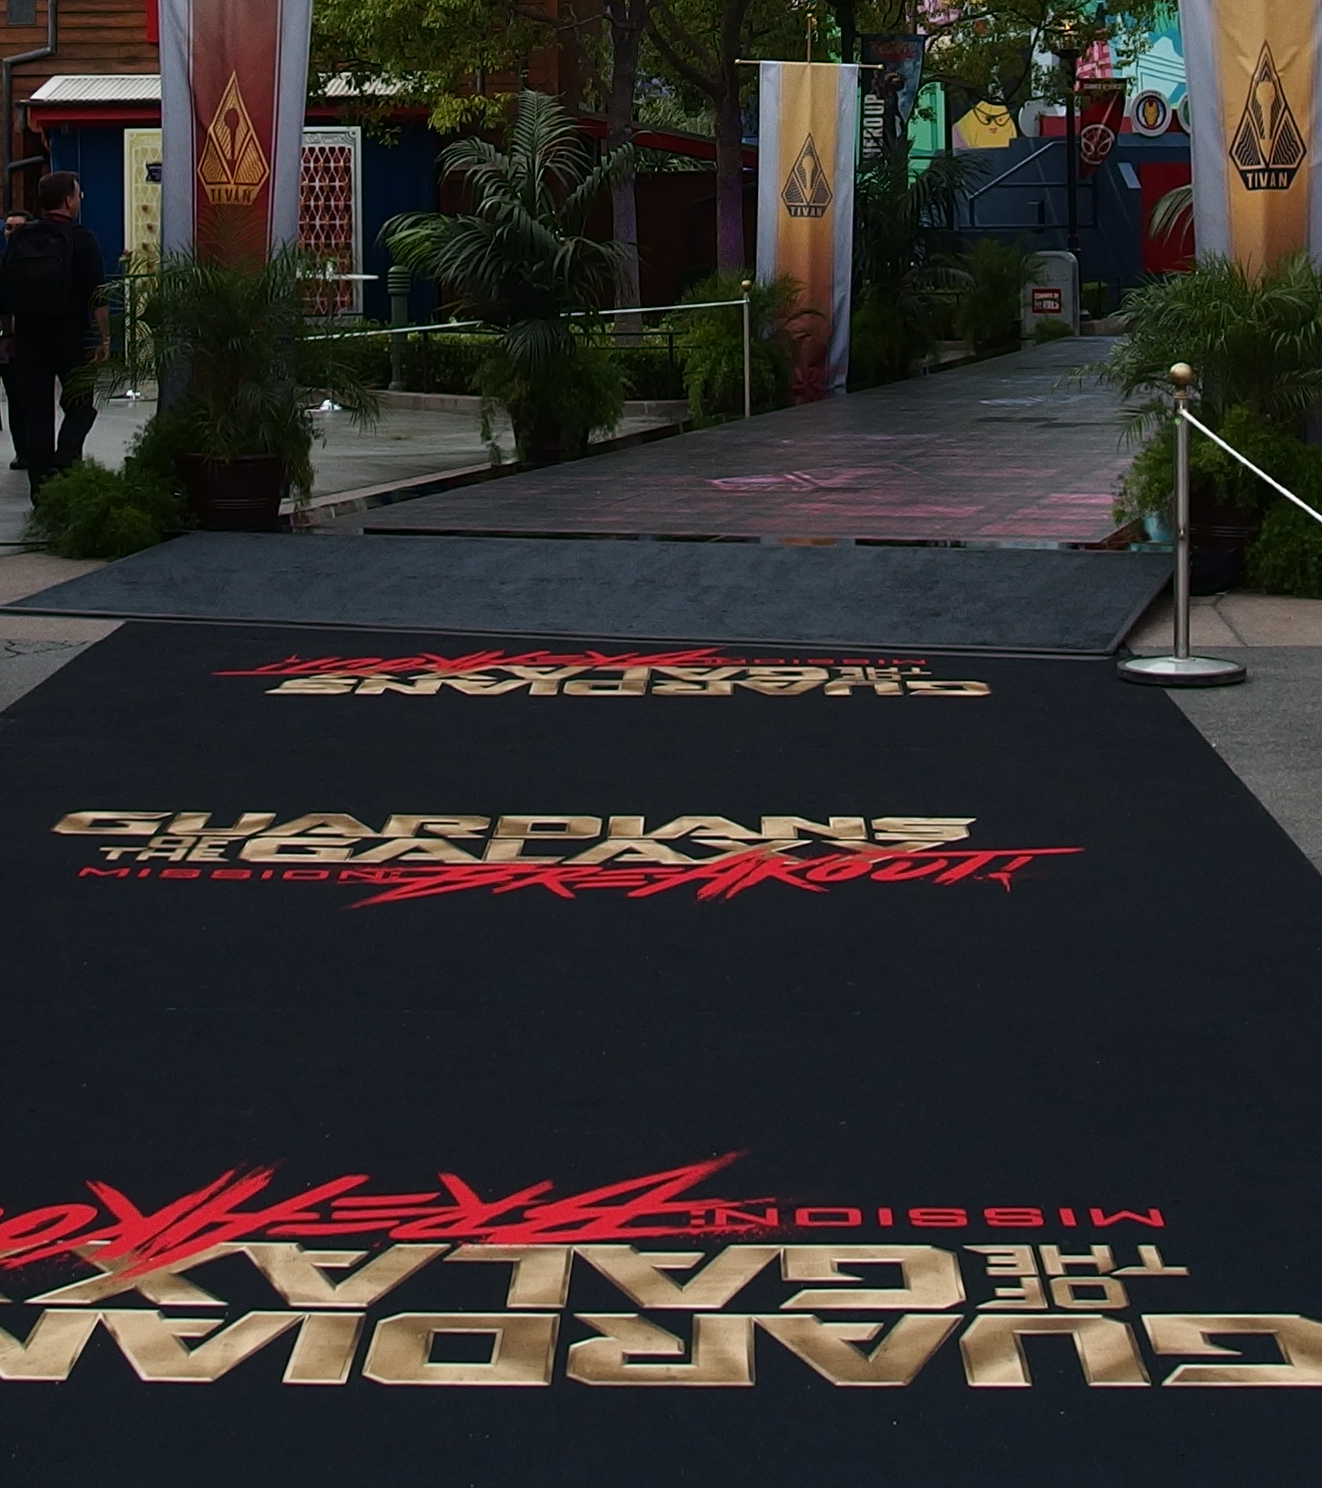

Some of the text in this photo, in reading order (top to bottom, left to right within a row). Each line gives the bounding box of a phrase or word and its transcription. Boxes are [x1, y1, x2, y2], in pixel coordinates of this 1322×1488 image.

[1246, 171, 1289, 189] TIVAN
[210, 188, 252, 203] TIVAN
[790, 206, 823, 217] TIVAN
[51, 810, 976, 840] GUARDIANS
[238, 836, 947, 865] GALAXY
[963, 1243, 1190, 1277] THE
[977, 1275, 1130, 1310] OF
